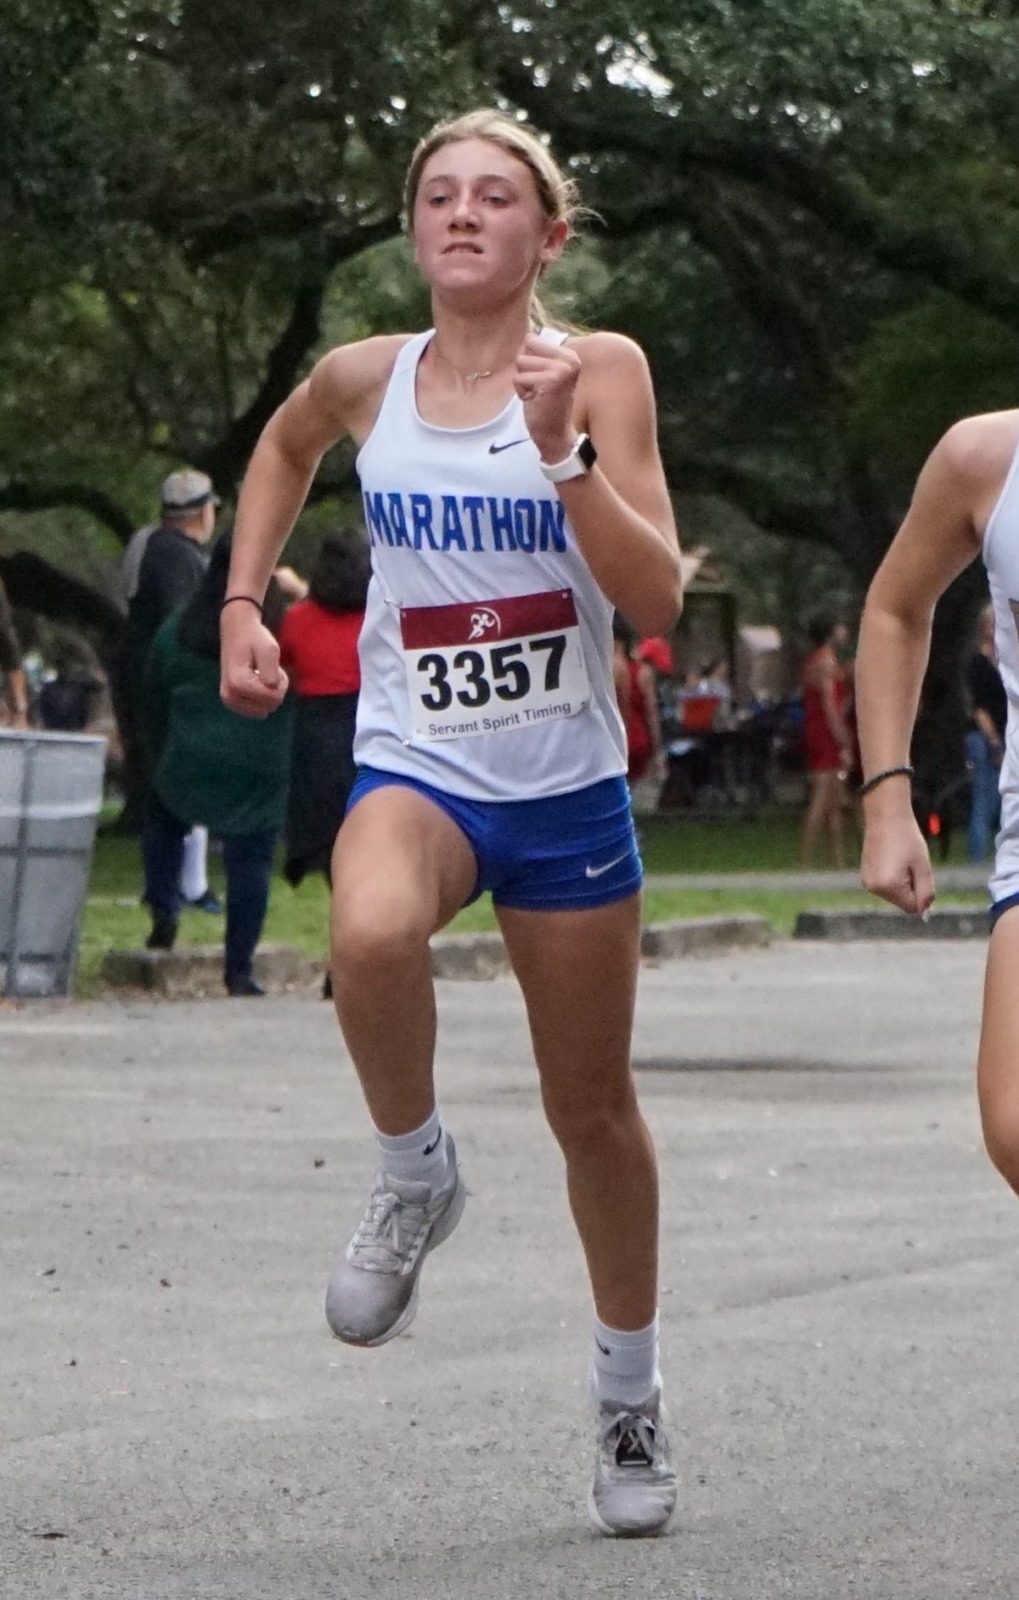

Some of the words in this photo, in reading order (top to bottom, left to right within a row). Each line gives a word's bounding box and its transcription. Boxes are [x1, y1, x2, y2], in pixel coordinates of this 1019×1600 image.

[364, 491, 567, 553] MARATHON
[417, 635, 567, 711] 3357
[428, 720, 478, 735] Servant
[482, 712, 520, 730] Spirit
[524, 702, 571, 721] Timing
